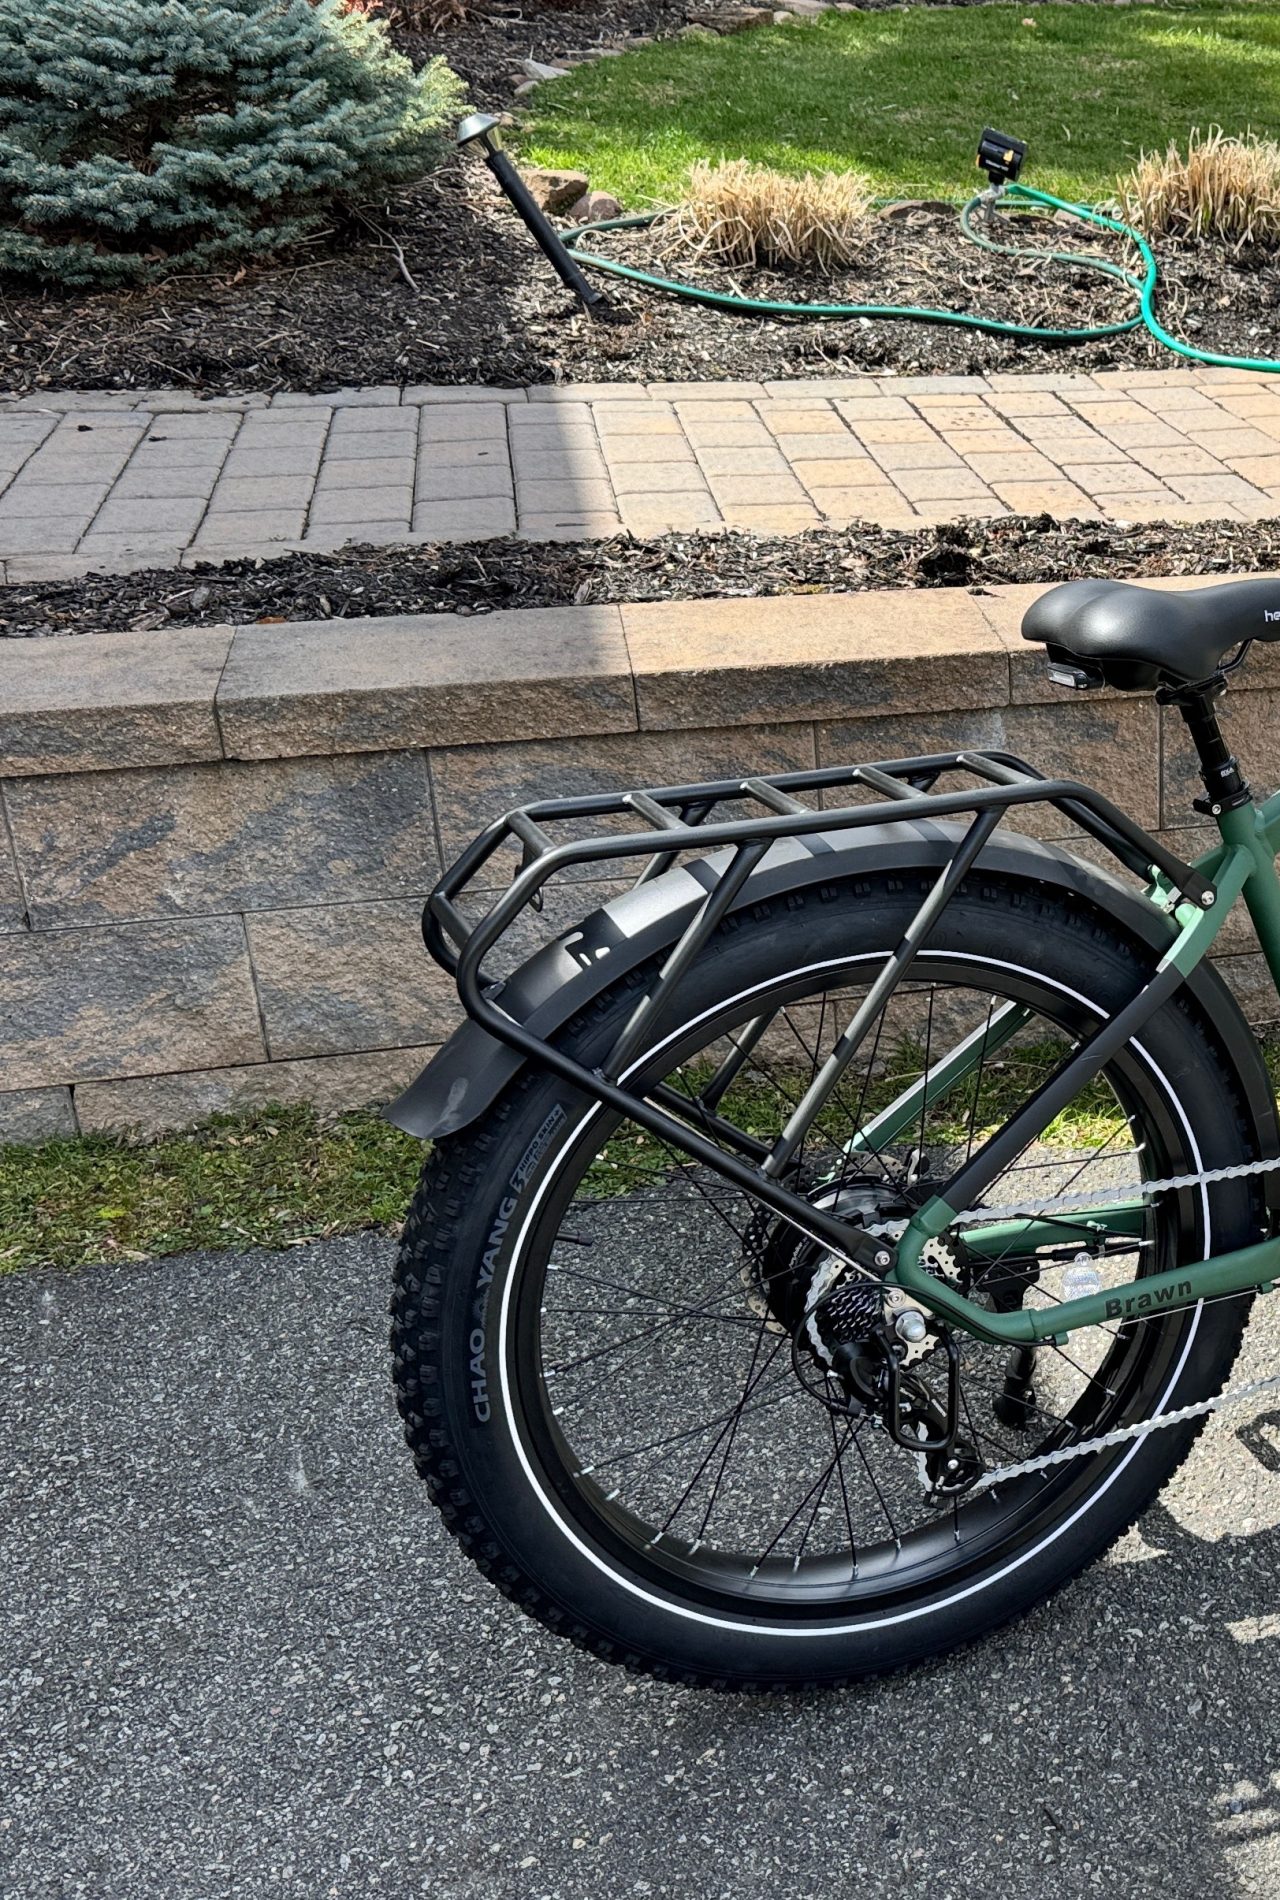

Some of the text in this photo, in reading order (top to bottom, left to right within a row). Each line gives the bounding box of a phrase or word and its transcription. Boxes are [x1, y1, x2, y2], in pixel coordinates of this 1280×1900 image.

[519, 1141, 539, 1172] HIPPO
[538, 1116, 556, 1139] SKIN
[469, 1196, 519, 1423] CHAO YANG
[1105, 1280, 1192, 1318] Brawn
